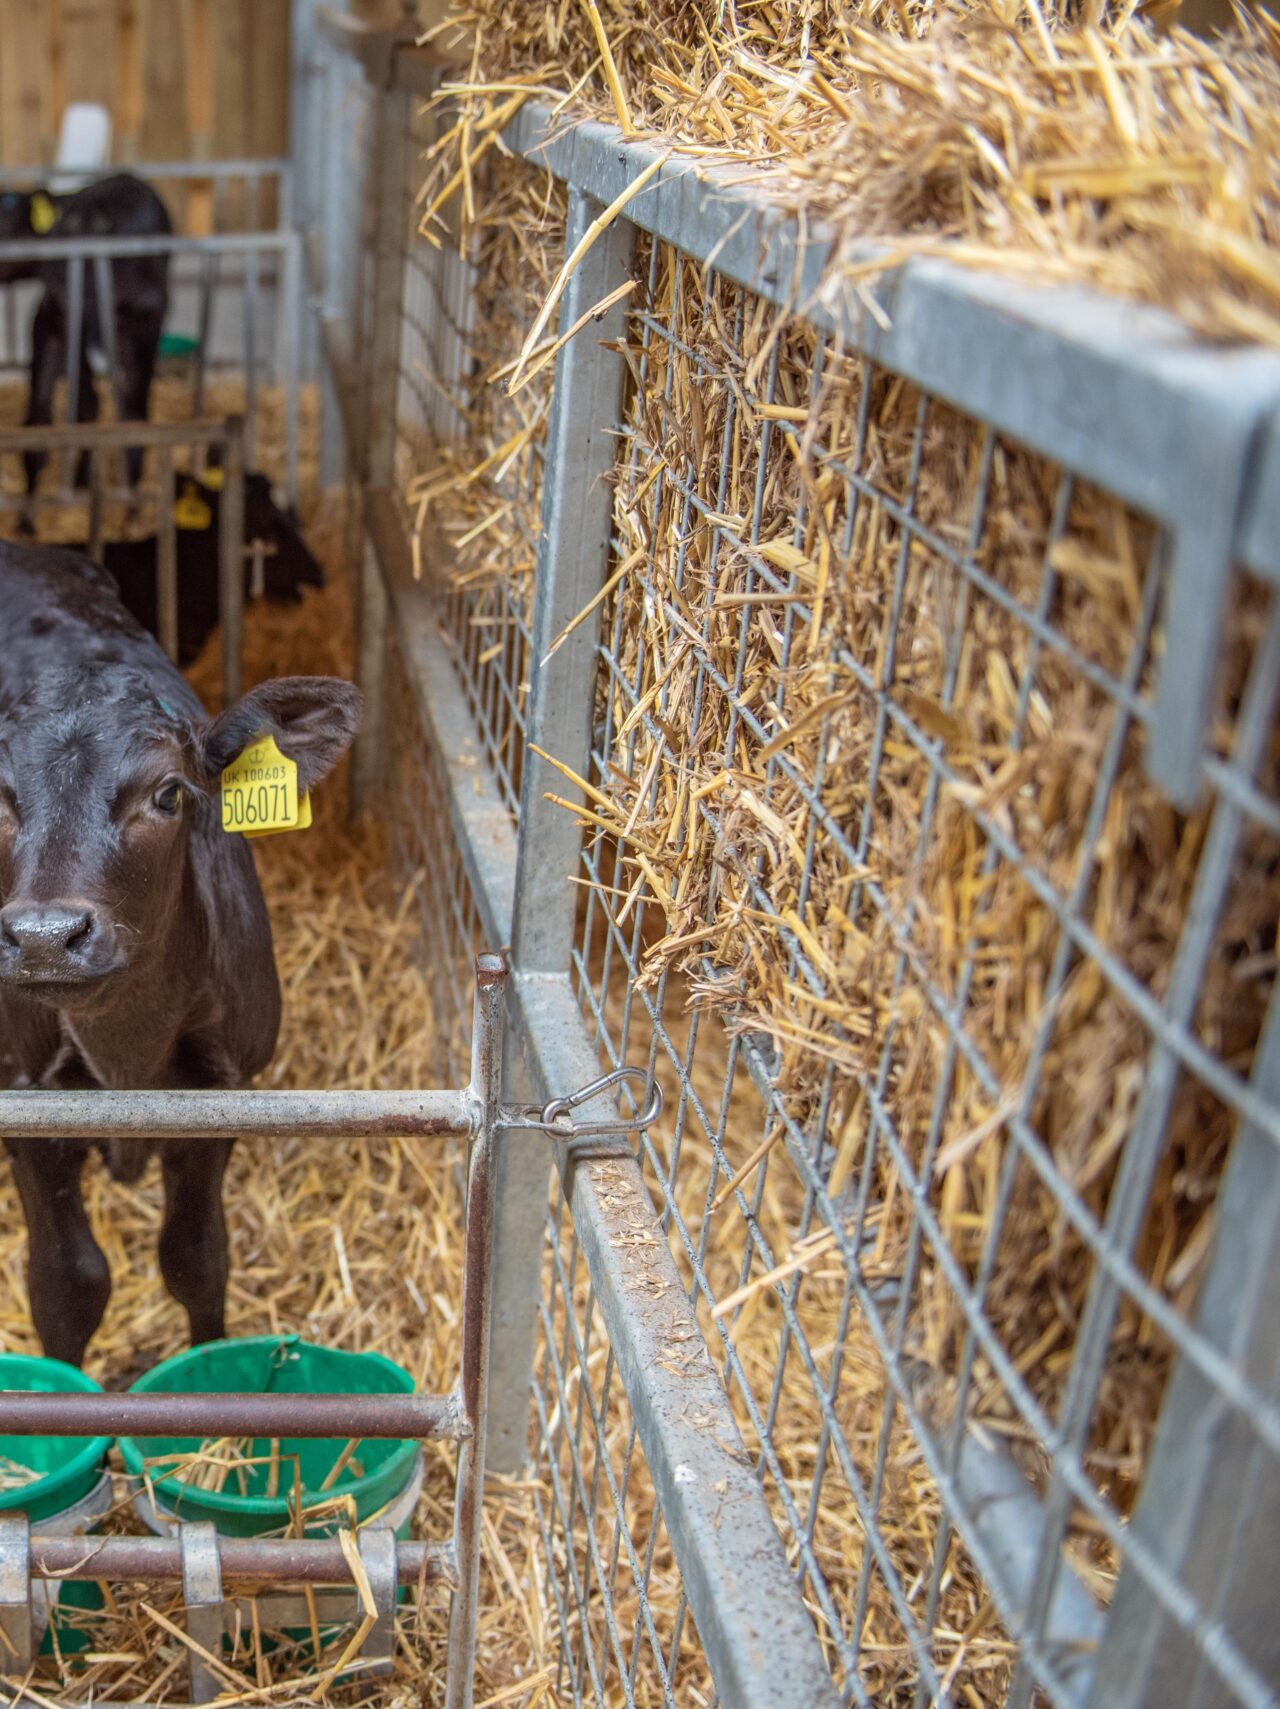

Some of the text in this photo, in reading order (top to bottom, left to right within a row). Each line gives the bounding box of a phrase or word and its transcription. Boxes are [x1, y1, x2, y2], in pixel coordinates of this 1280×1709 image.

[224, 766, 286, 784] UK 100603
[223, 784, 291, 826] 506071
